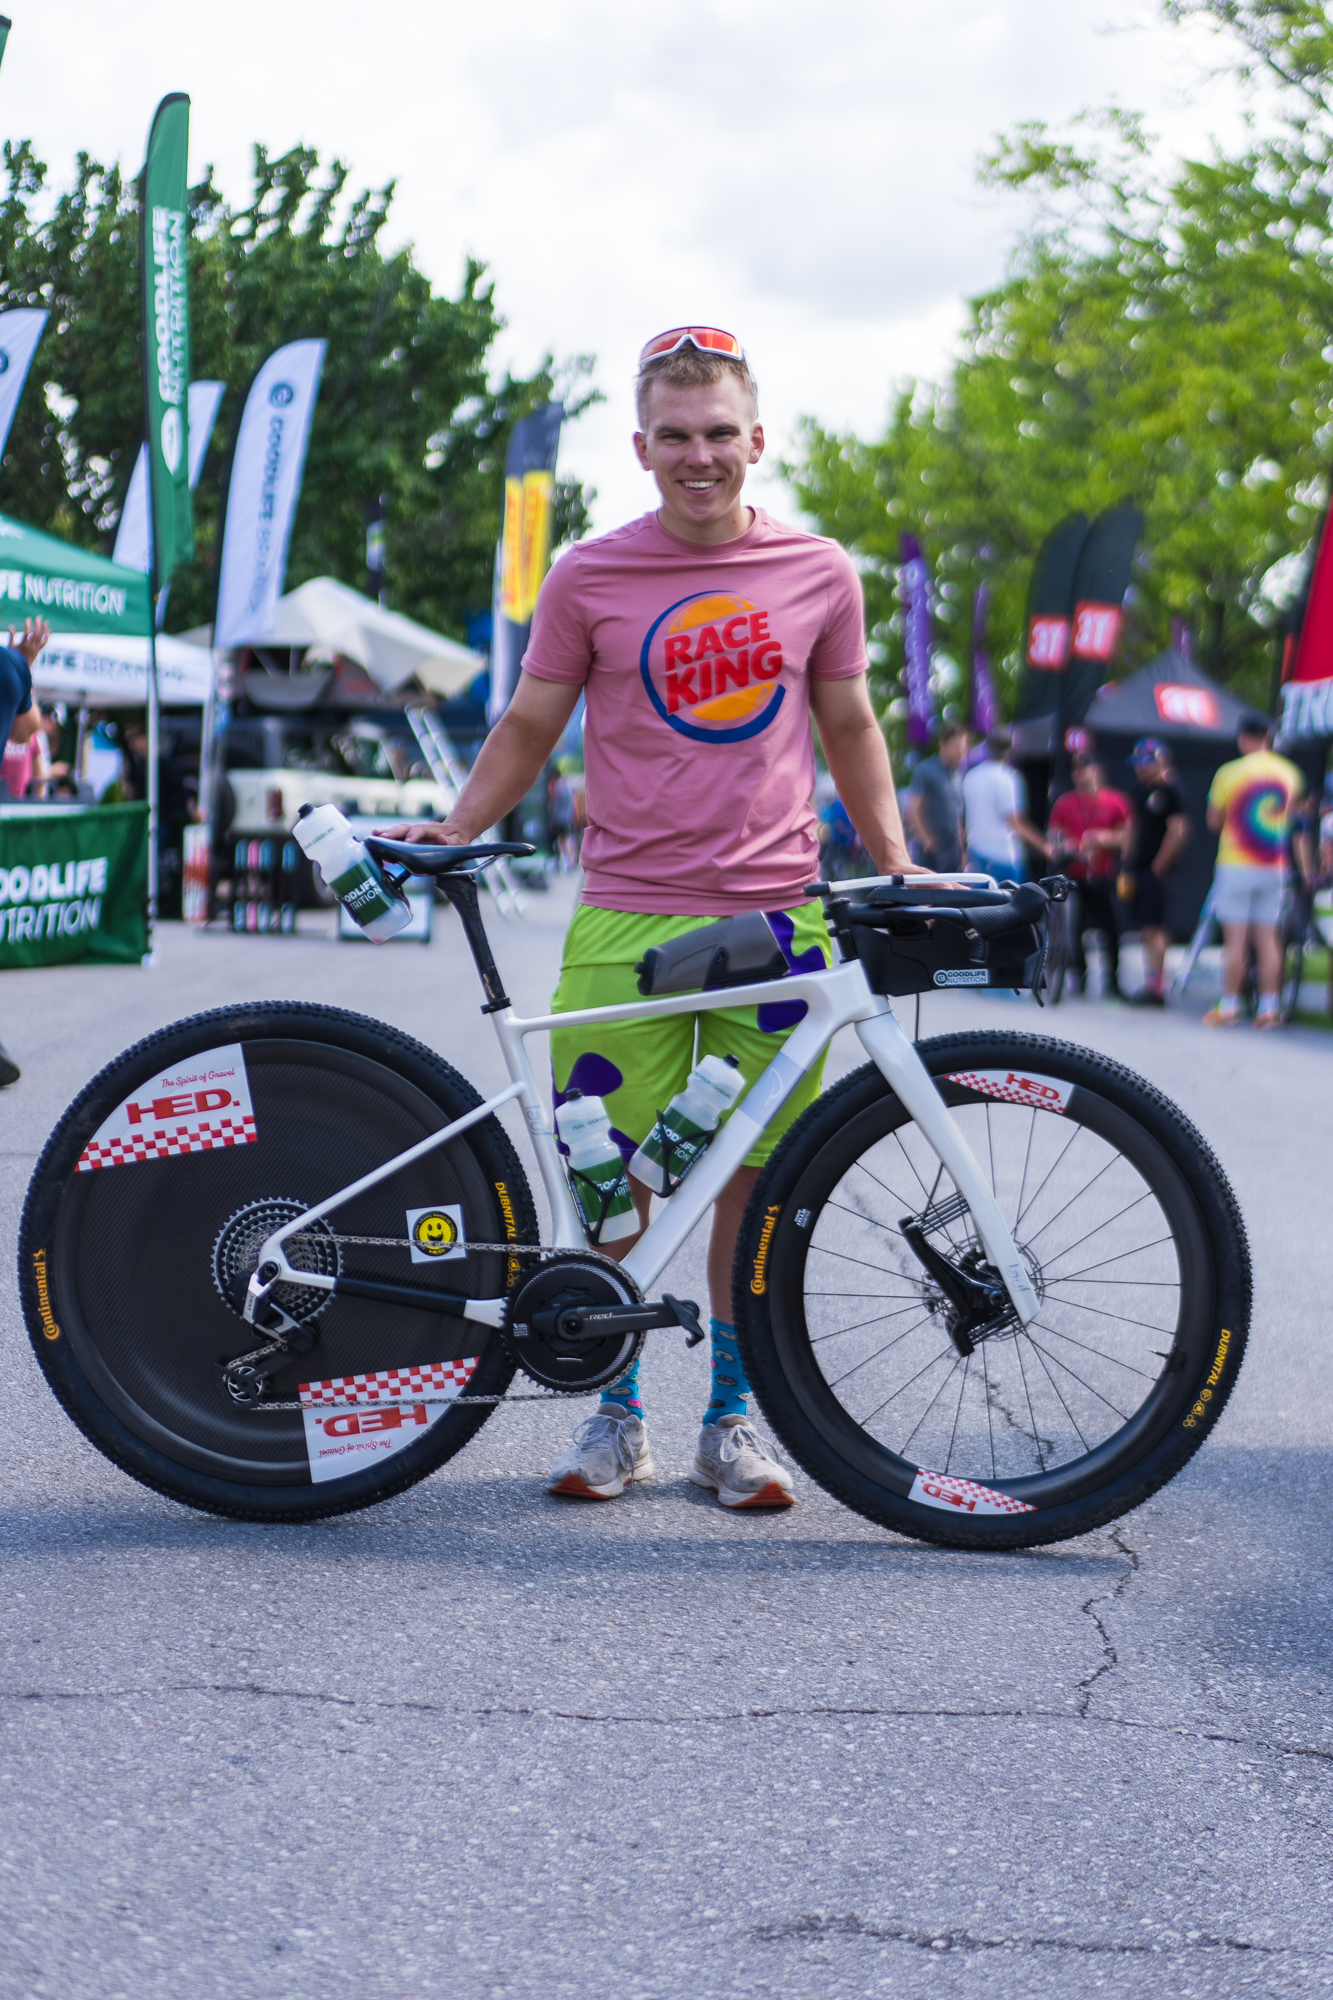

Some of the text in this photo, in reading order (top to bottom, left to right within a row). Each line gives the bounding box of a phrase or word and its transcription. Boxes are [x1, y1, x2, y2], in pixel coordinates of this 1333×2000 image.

[25, 573, 127, 617] NUTRITION
[664, 611, 770, 672] RACE
[665, 641, 782, 715] KING
[947, 970, 986, 978] GOODLIFE
[947, 976, 987, 984] NUTRITION
[161, 1068, 235, 1088] The Spirit of Gravel
[495, 1182, 516, 1239] DUBNITAL
[750, 1215, 776, 1294] Continental
[33, 1261, 60, 1340] Continental
[1206, 1328, 1231, 1386] DUBNITAL
[318, 1438, 392, 1457] The Spirit of Gravel
